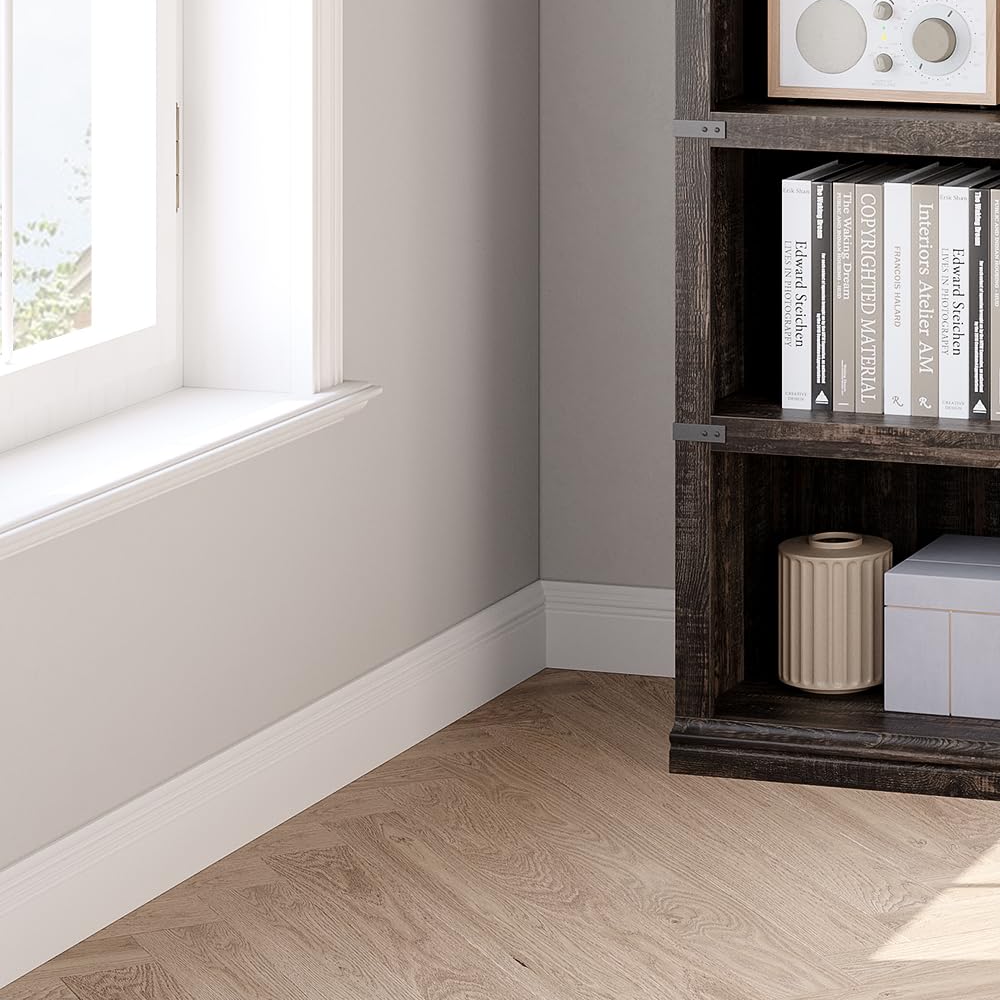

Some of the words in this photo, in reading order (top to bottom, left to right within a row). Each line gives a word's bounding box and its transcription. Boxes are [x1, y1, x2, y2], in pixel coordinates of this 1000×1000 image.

[843, 192, 852, 214] The
[784, 240, 792, 265] LIVES
[841, 217, 852, 259] Waking
[860, 193, 876, 315] COPYRIGHTED
[919, 202, 934, 276] Interiors
[784, 268, 792, 278] IN
[795, 241, 807, 289] Edward
[842, 263, 852, 300] Dream
[894, 246, 902, 289] FRANCOIS
[941, 248, 949, 273] LIVES
[941, 275, 949, 285] IN
[952, 248, 965, 297] Edward
[795, 293, 807, 347] Steichen
[894, 292, 902, 328] HALARD
[919, 280, 935, 337] Atelier
[952, 301, 965, 356] Steichen
[860, 319, 876, 404] MATERIAL
[919, 341, 934, 374] AM
